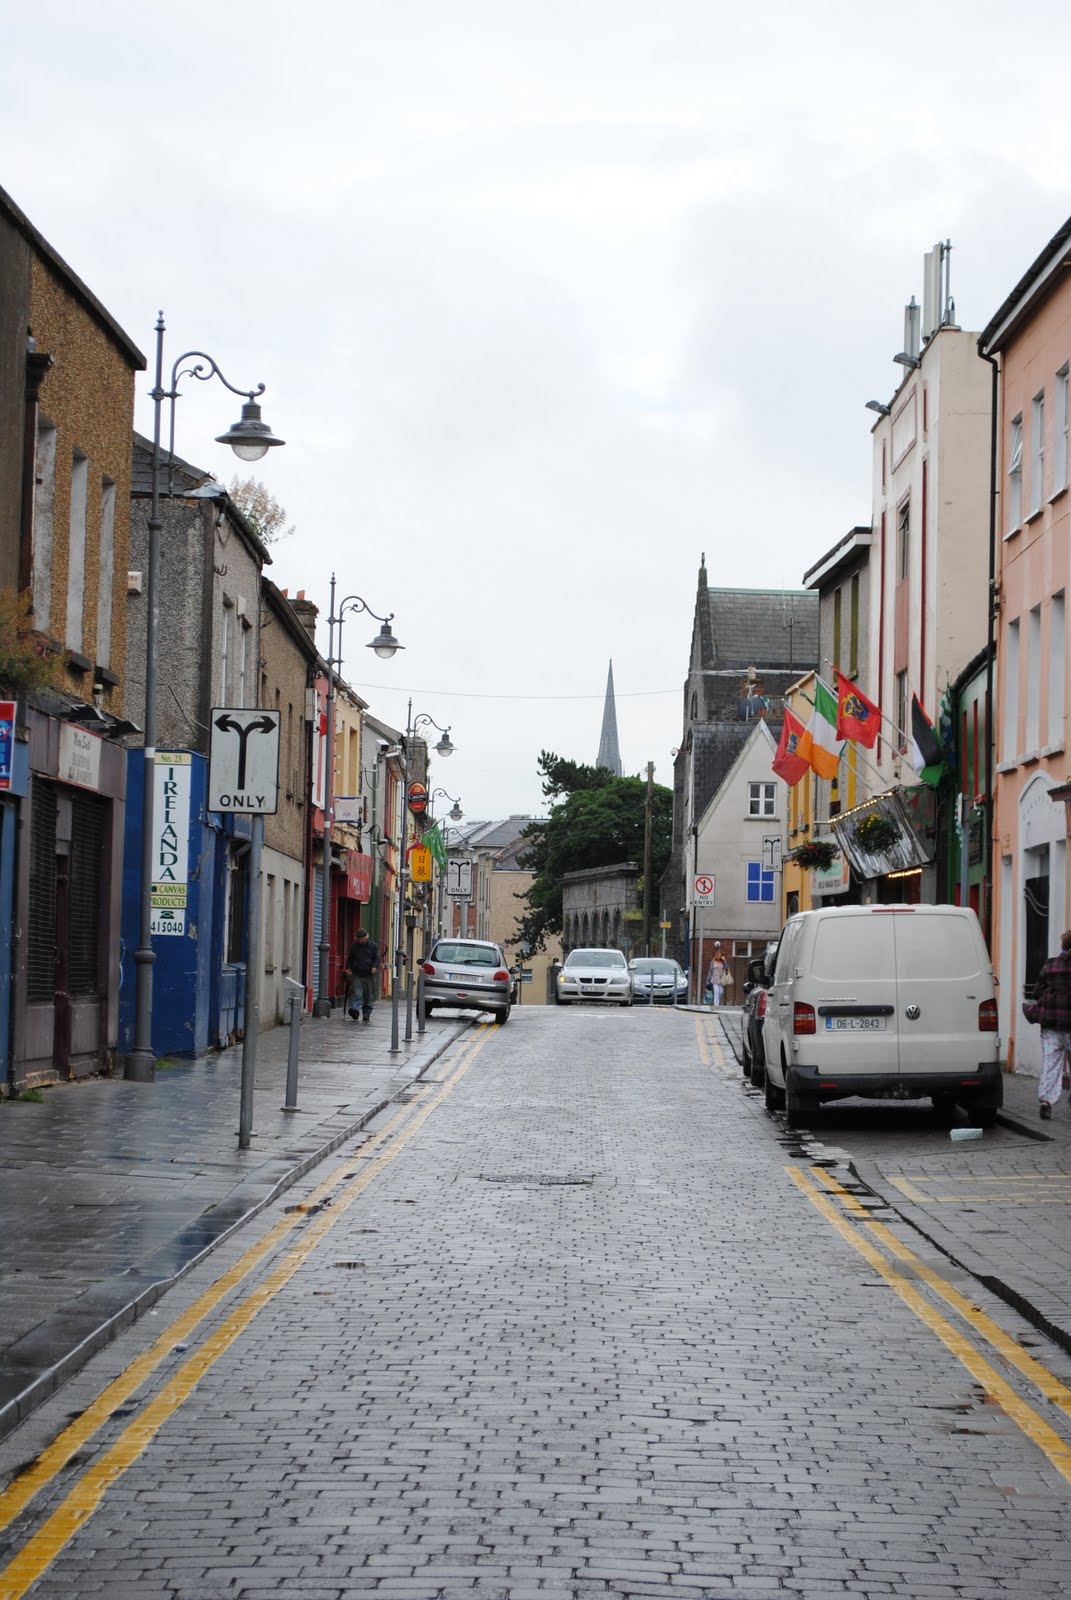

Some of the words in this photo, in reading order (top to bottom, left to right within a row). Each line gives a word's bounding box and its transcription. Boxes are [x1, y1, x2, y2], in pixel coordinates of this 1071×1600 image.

[161, 754, 172, 763] No.
[219, 794, 265, 808] ONLY
[159, 767, 179, 881] IRELANDA
[159, 884, 186, 894] CANVAS
[151, 897, 186, 906] RODUCTS
[151, 921, 183, 933] 415040
[836, 1018, 880, 1029] 06-L-2843
